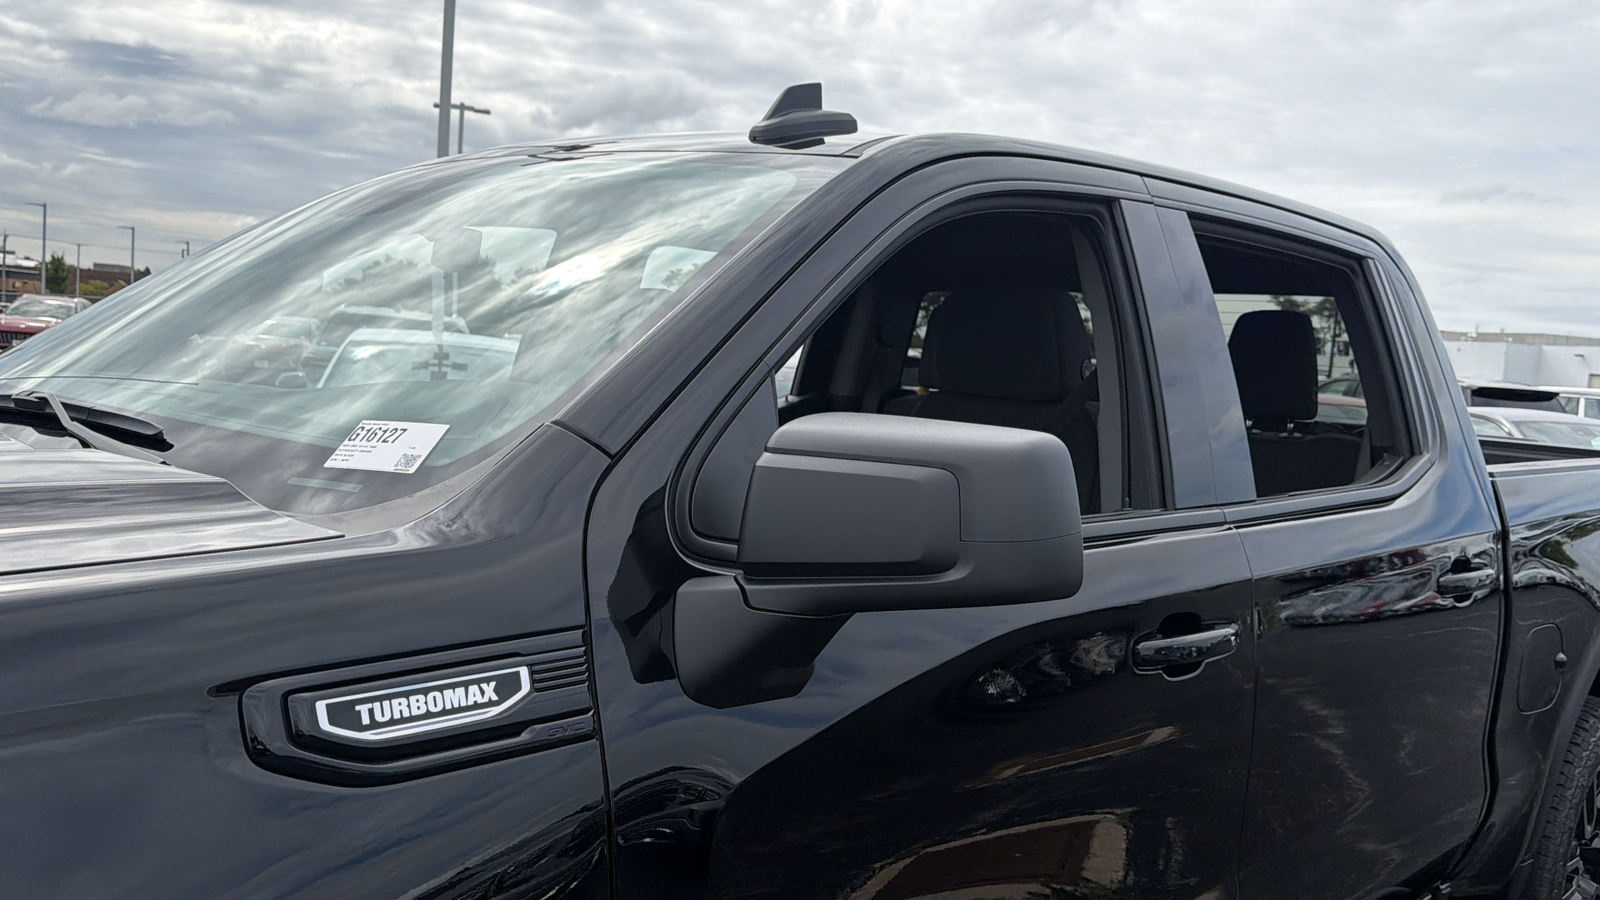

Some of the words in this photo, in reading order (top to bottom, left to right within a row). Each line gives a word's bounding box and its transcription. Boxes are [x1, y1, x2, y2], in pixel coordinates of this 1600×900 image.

[347, 426, 408, 444] G16127
[355, 681, 498, 725] TURBOMAX
[546, 721, 586, 737] GMC
